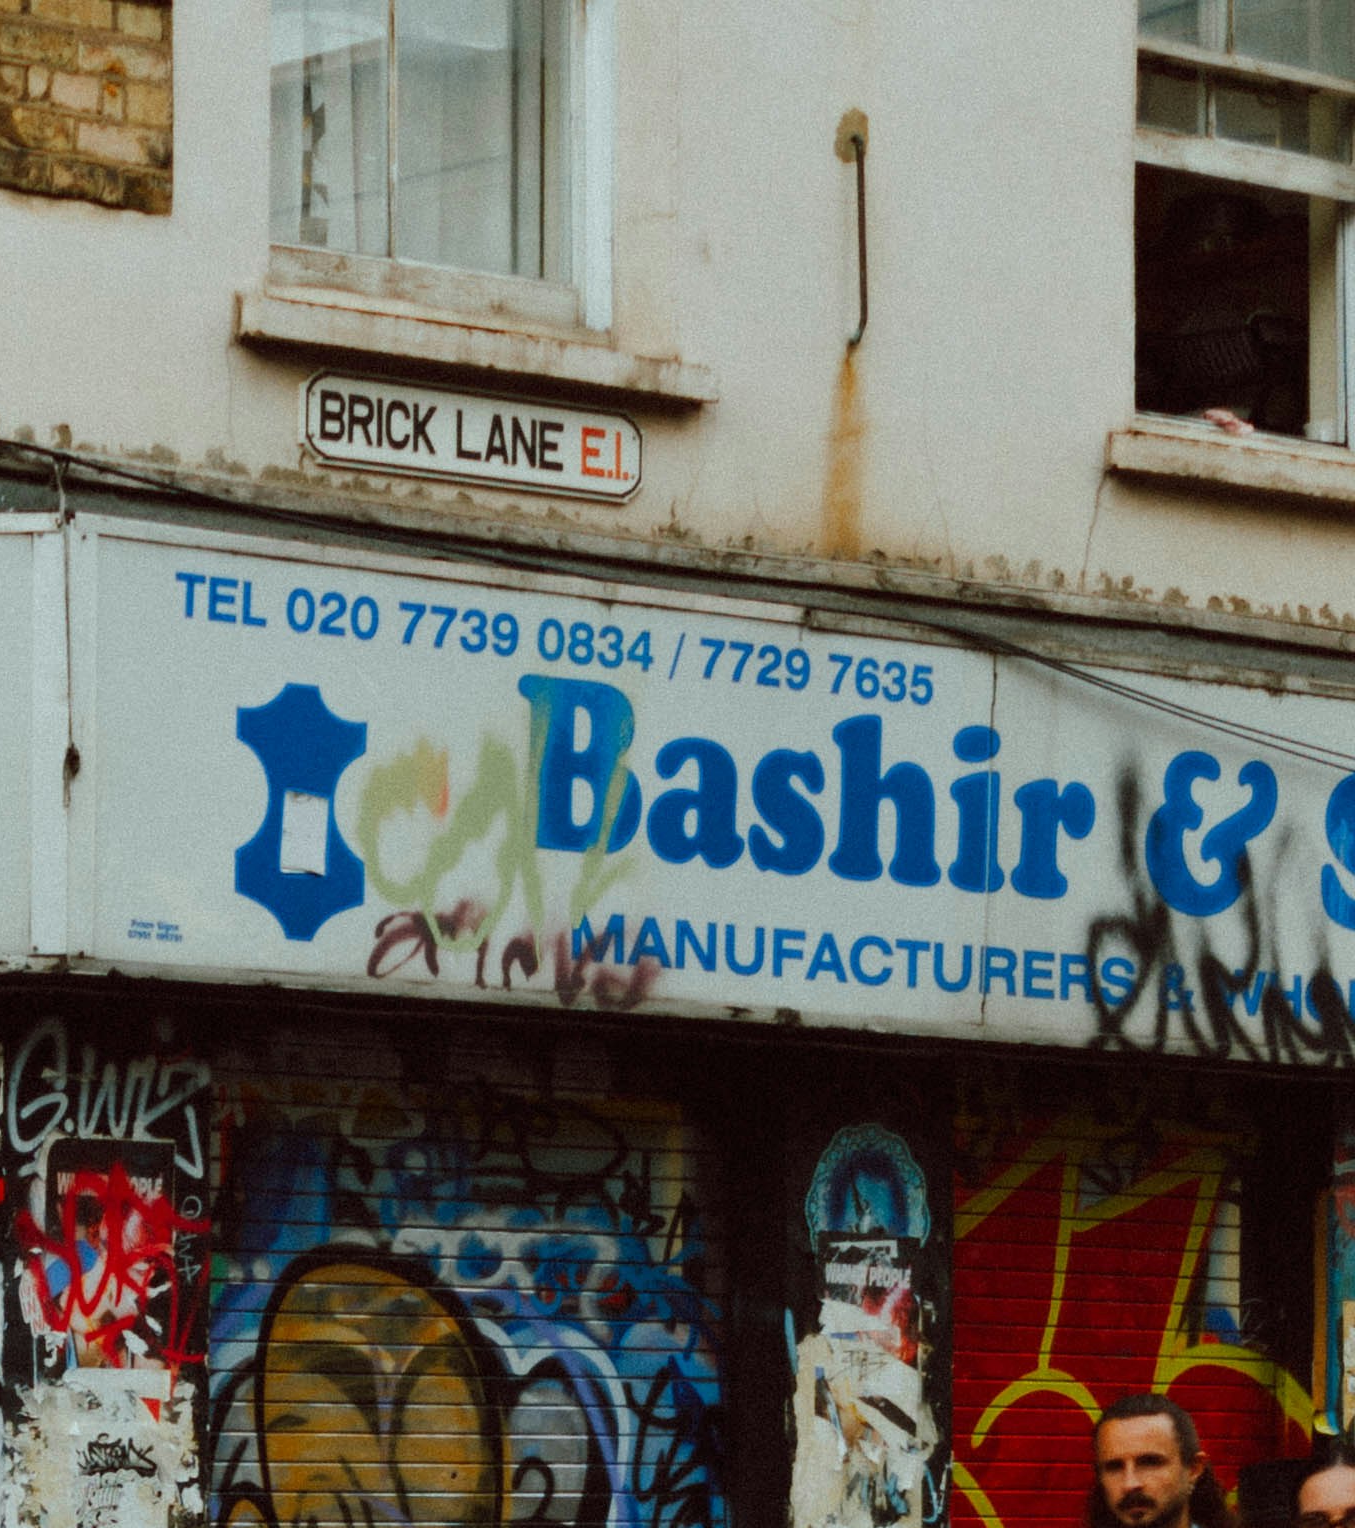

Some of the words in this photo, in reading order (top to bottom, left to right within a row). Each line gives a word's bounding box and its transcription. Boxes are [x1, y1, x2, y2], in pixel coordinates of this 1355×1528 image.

[319, 390, 437, 455] BRICK
[455, 409, 565, 472] LANE
[176, 571, 267, 627] TEL
[286, 587, 380, 641] 020
[399, 601, 520, 657] 7739
[537, 618, 653, 672] 0834
[700, 637, 811, 692] 7729
[828, 653, 934, 706] 7635
[518, 674, 1094, 898] Bashir
[1145, 750, 1277, 917] &
[571, 914, 1136, 1006] MANUFACTURERS
